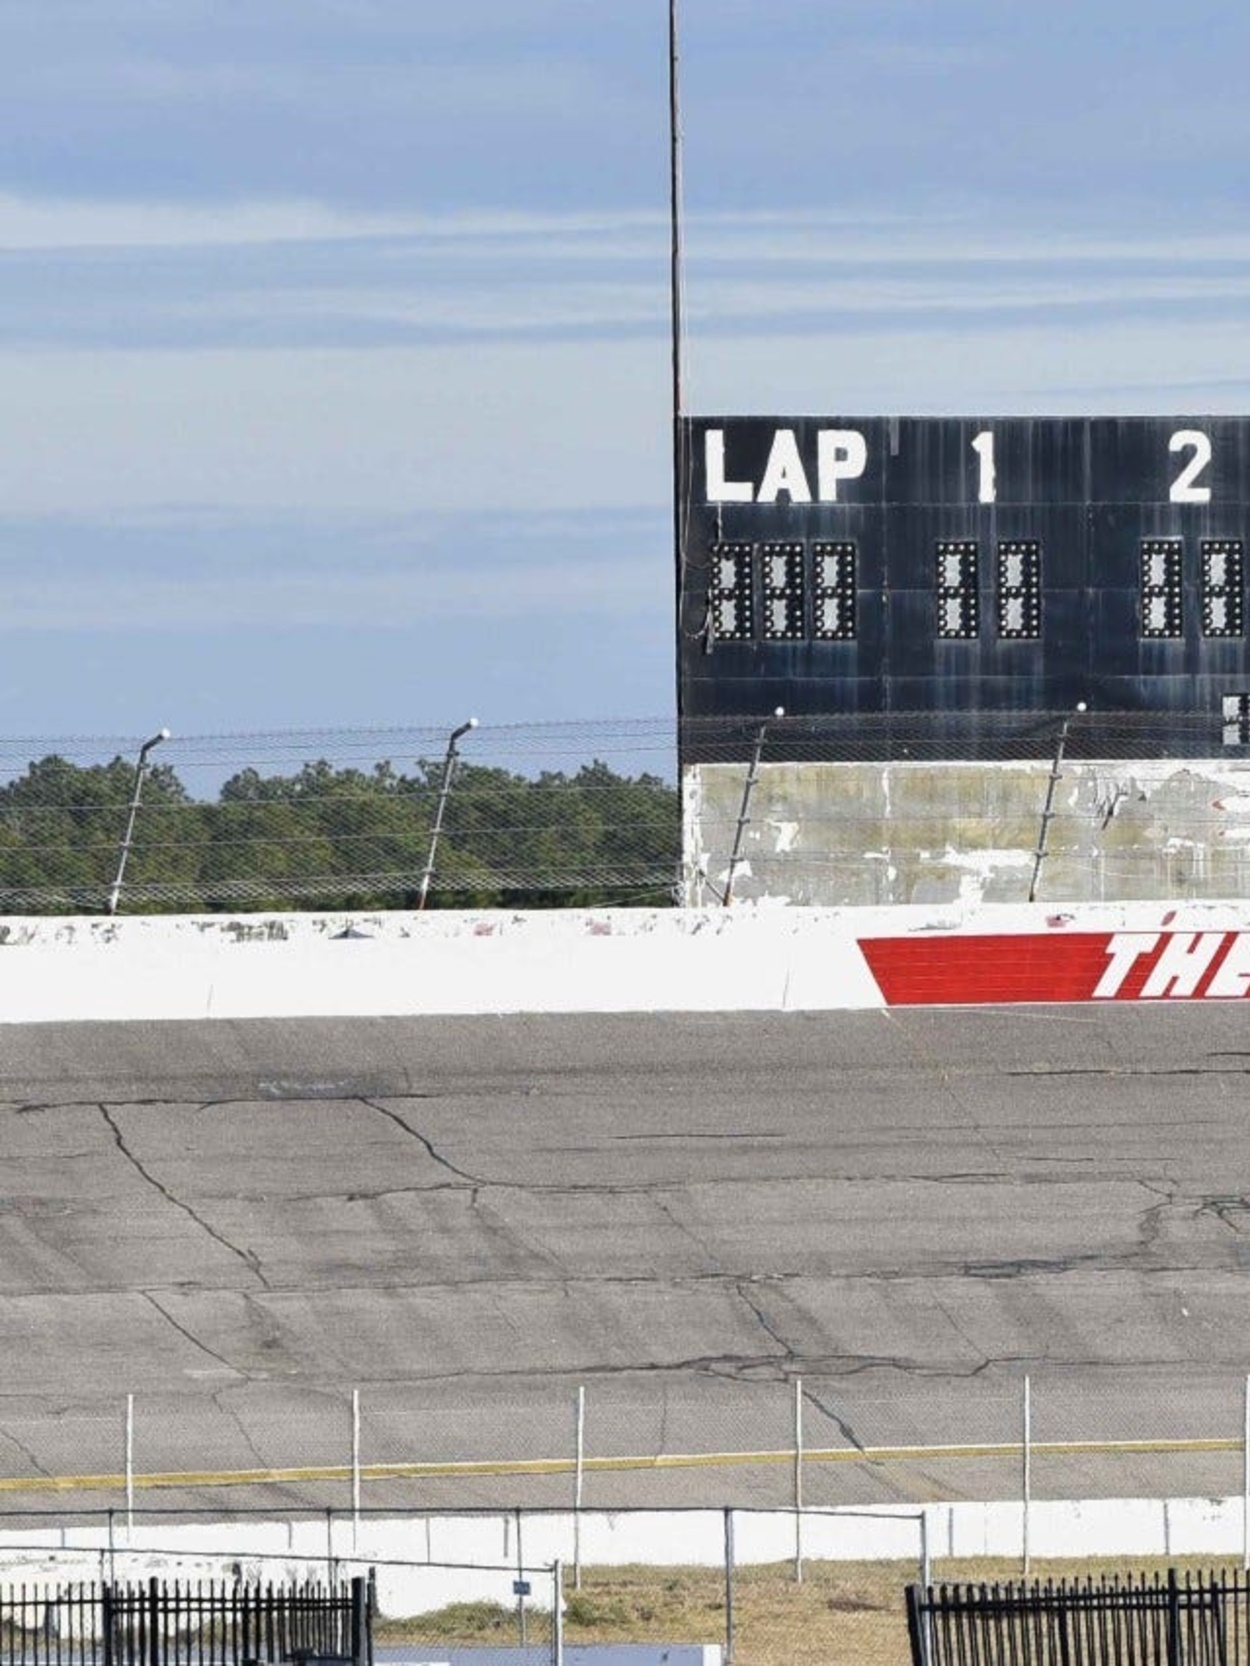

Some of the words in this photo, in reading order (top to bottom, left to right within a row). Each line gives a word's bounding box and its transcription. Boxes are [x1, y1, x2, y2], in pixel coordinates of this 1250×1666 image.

[705, 429, 867, 502] LAP
[971, 431, 997, 502] 1
[1168, 430, 1212, 501] 2
